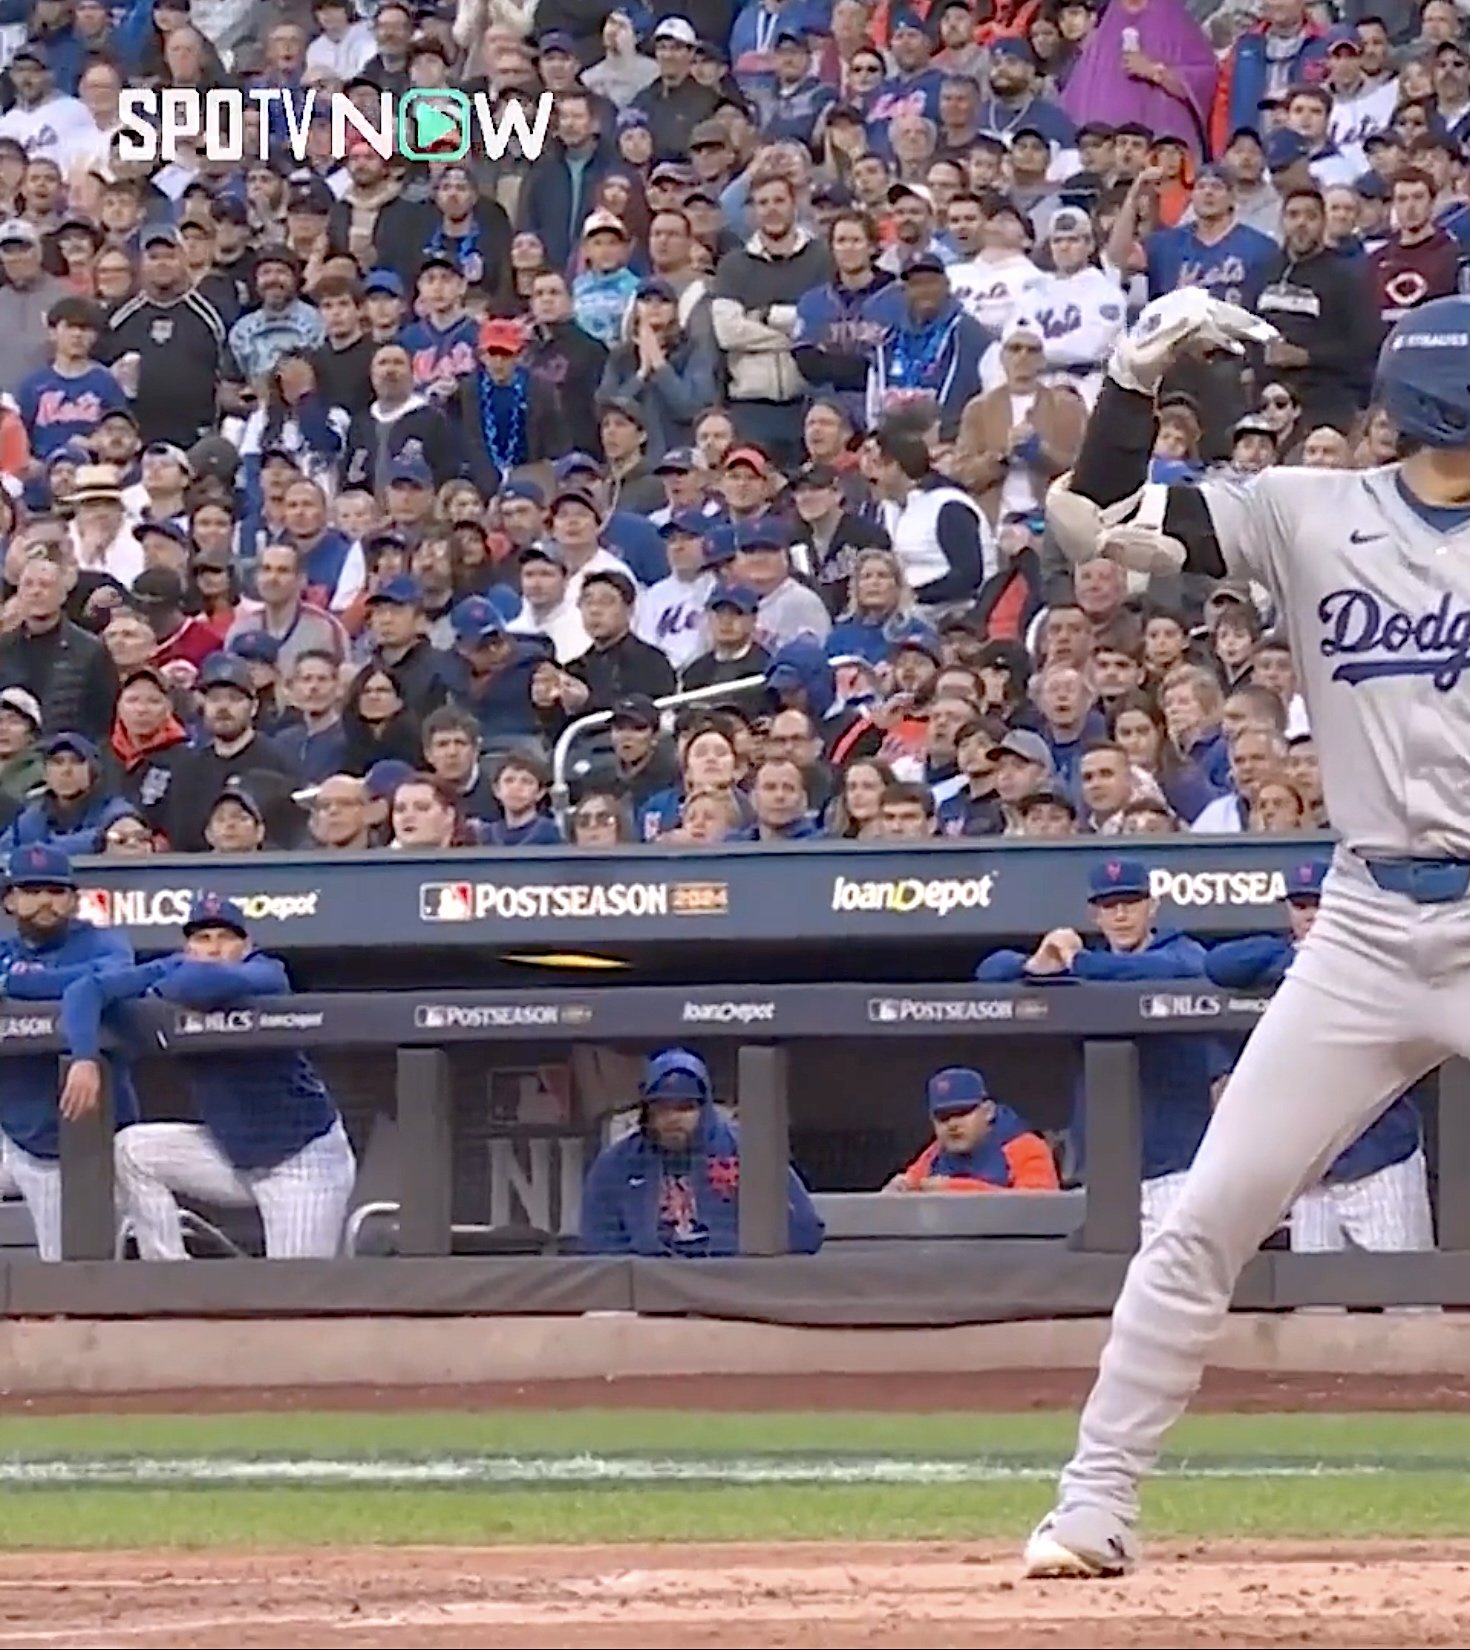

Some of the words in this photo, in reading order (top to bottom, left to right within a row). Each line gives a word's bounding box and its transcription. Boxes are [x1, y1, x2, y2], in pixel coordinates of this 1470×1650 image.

[475, 883, 668, 919] POSTSEASON
[831, 874, 995, 917] loanDepot
[1148, 867, 1288, 906] POSTSEA
[113, 889, 193, 926] NLCS
[447, 1004, 558, 1028] POSTSEASON
